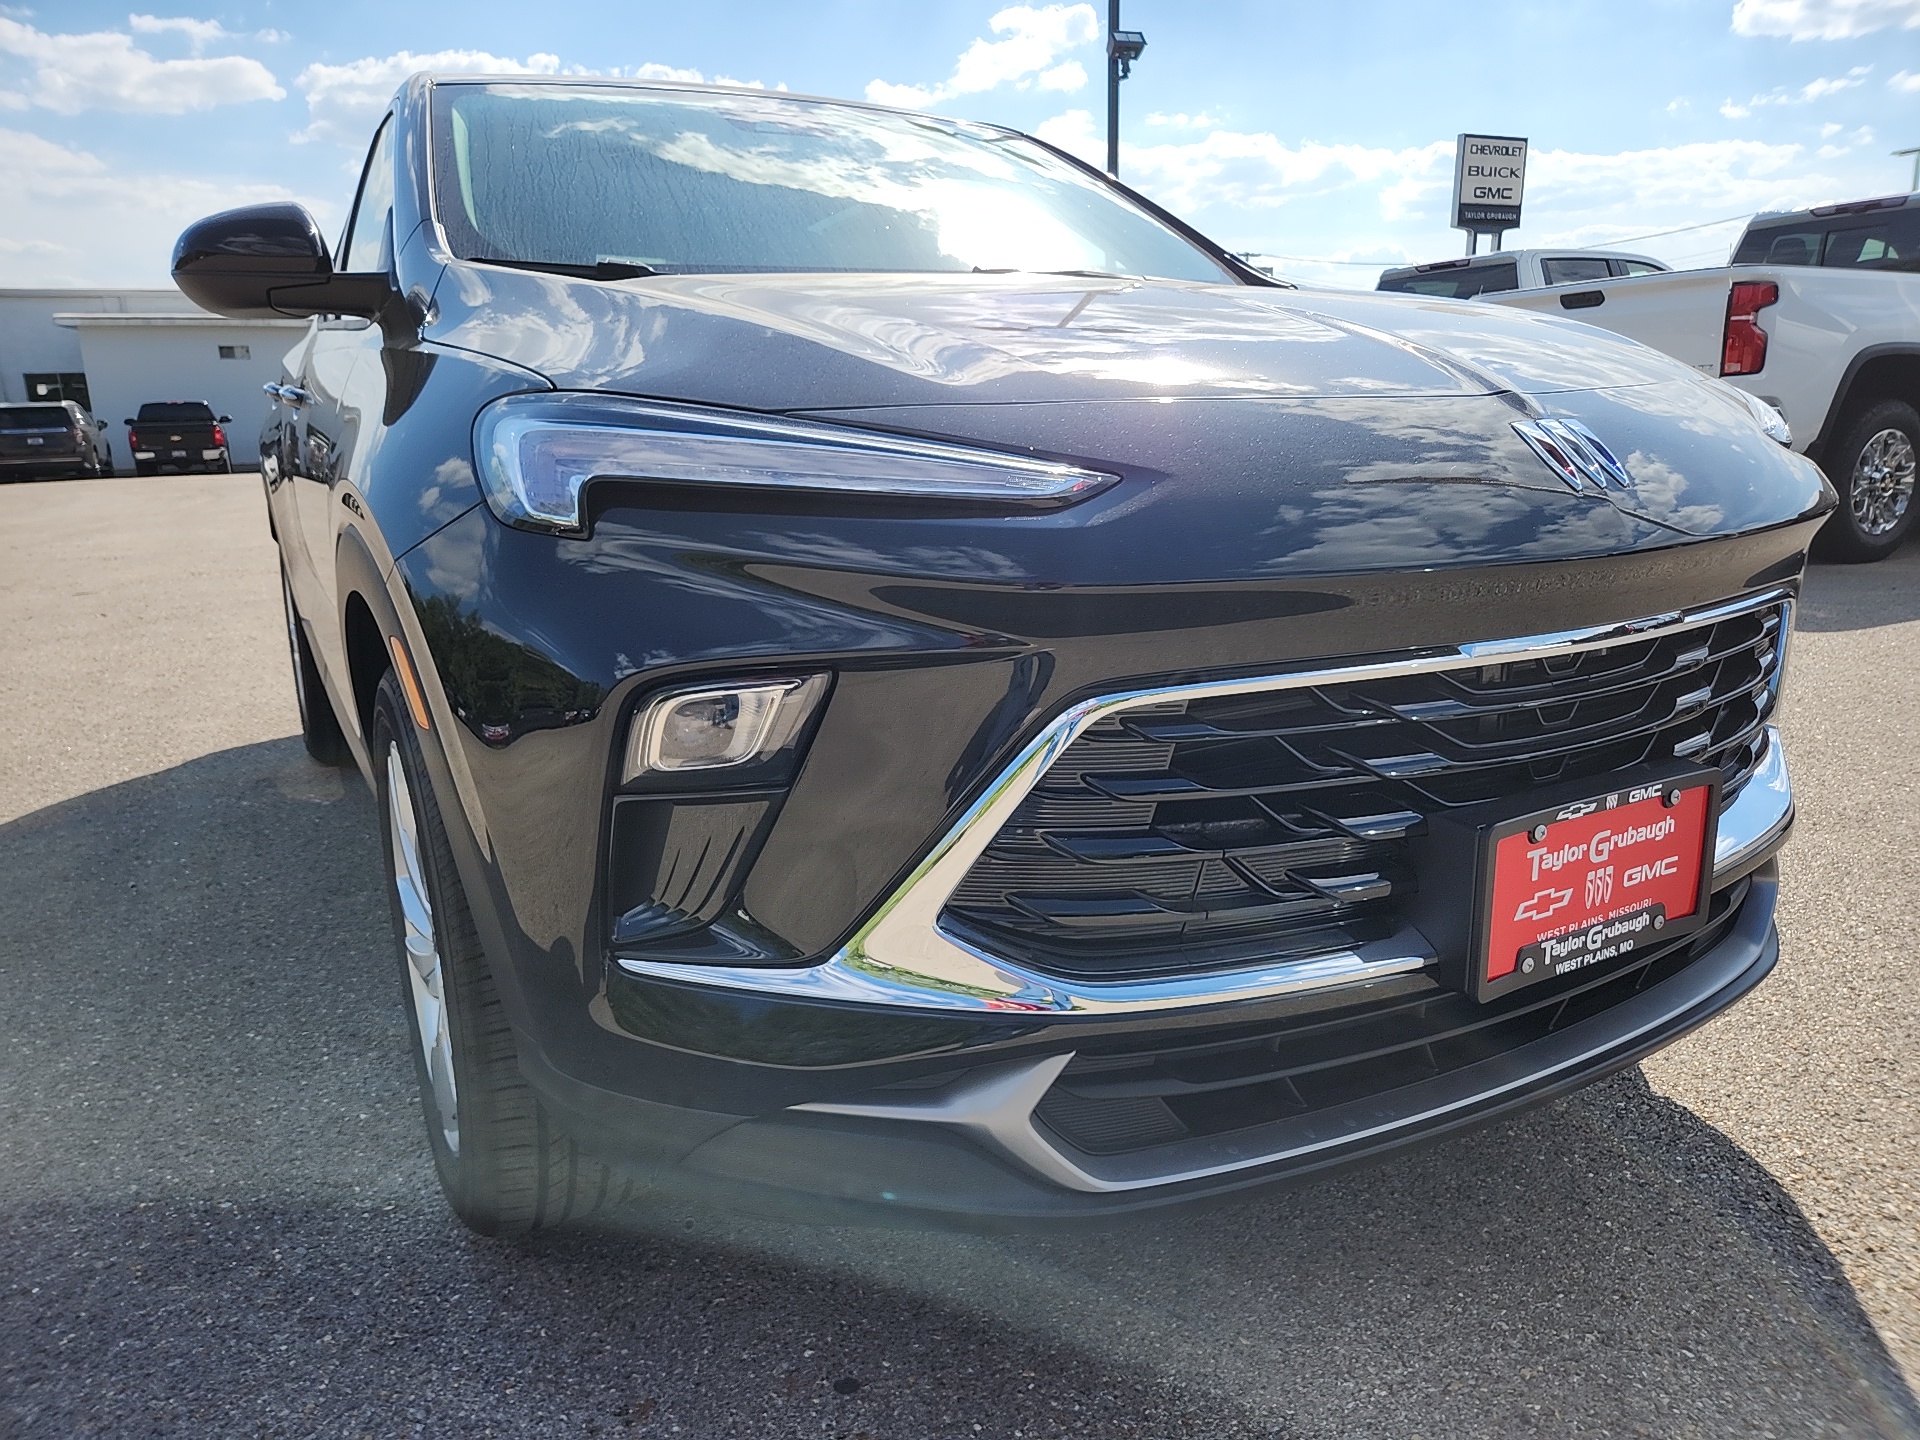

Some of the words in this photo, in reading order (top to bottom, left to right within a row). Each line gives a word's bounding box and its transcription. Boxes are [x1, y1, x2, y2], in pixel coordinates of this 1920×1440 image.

[1470, 144, 1523, 157] CHEVROLET
[1468, 165, 1521, 179] BUICK
[1473, 186, 1513, 199] GMC
[1464, 211, 1485, 219] TAYLOR
[1628, 783, 1663, 804] GMC
[1526, 843, 1588, 882] Taylor
[1588, 815, 1676, 864] Grubaugh
[1623, 855, 1679, 888] GMC
[1536, 926, 1567, 943] WEST
[1608, 898, 1653, 920] MISSOURI
[1540, 934, 1586, 965] Taylor
[1586, 911, 1650, 951] Grubaugh
[1555, 956, 1584, 975] WEST
[1583, 945, 1618, 967] PLAINS,
[1619, 939, 1634, 955] MO
